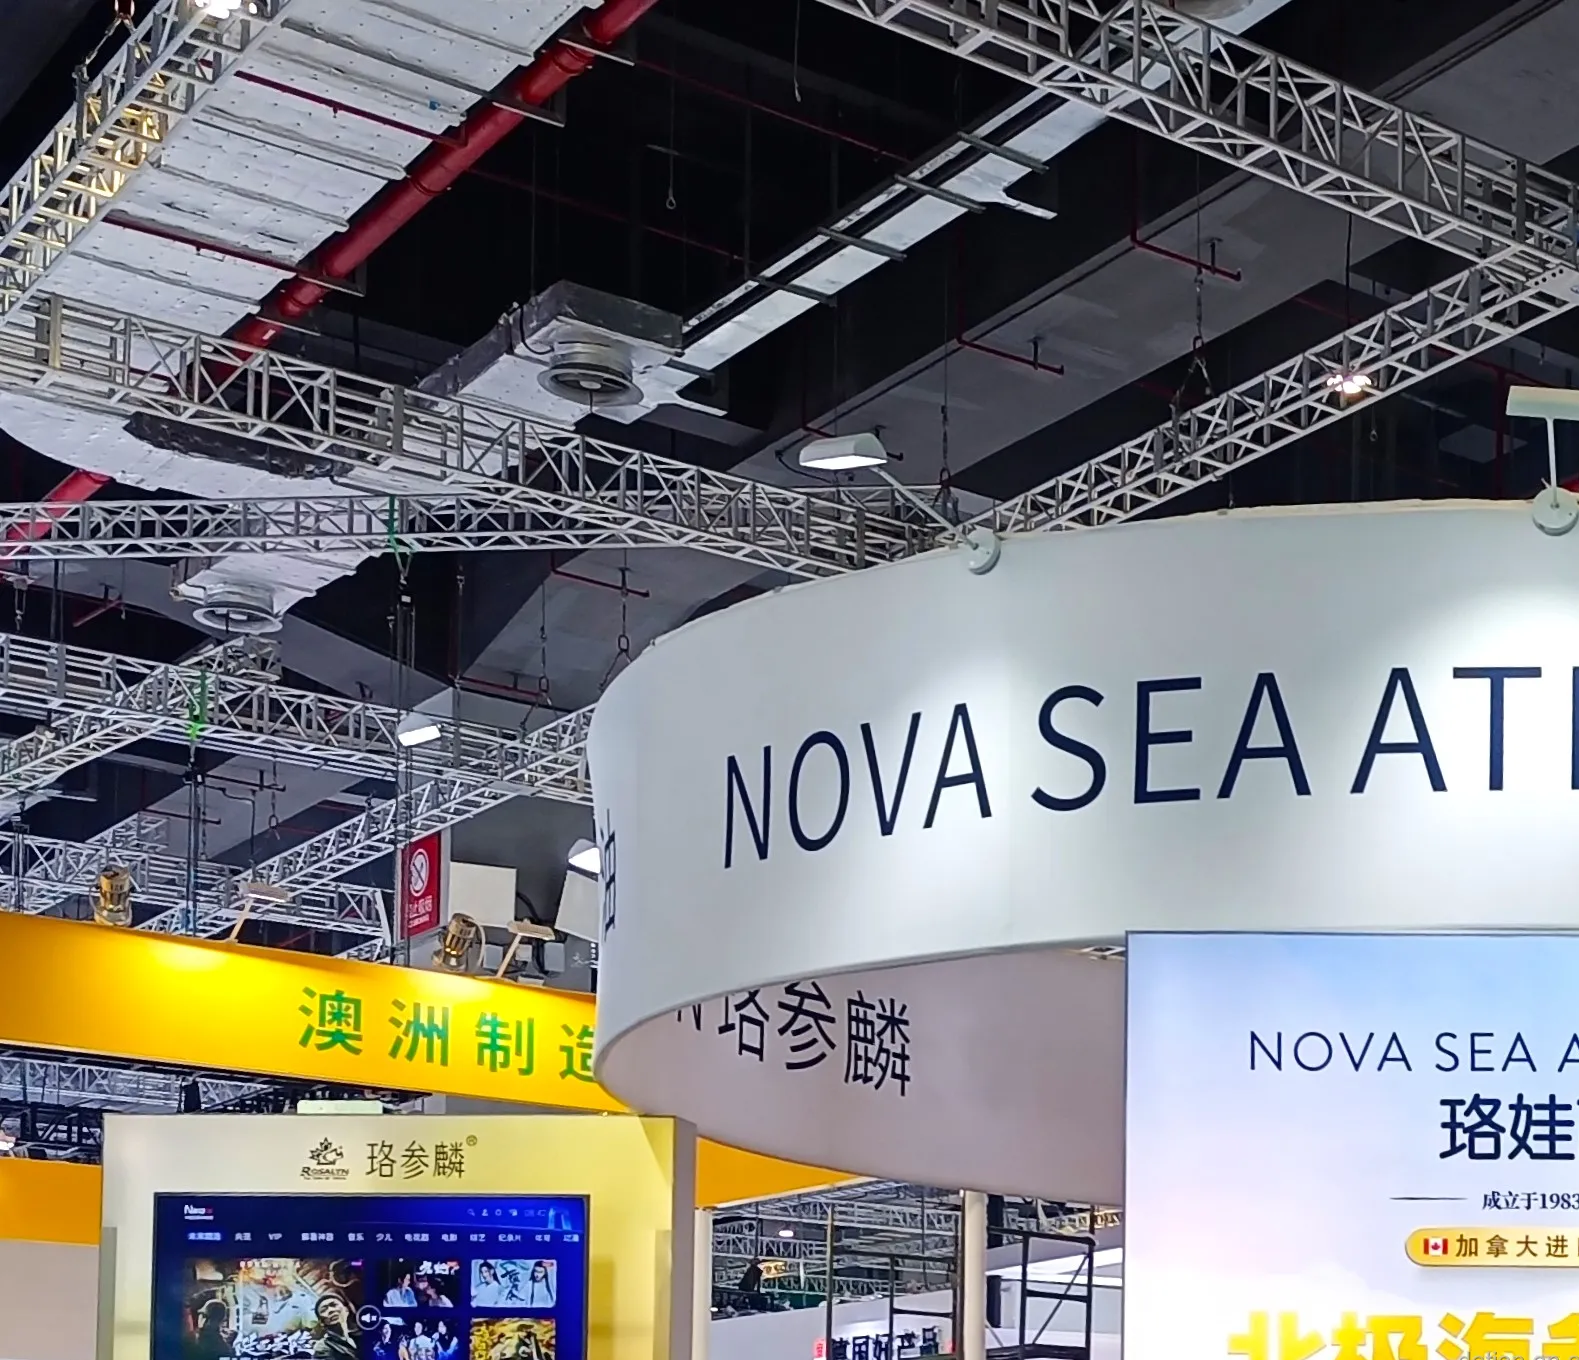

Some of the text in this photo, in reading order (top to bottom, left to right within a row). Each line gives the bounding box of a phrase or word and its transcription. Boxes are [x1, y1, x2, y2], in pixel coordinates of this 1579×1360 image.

[724, 702, 993, 869] NOVA
[1030, 672, 1312, 812] SEA
[297, 985, 597, 1082] 澳洲制造
[1249, 1030, 1412, 1073] NOVA
[1433, 1031, 1538, 1074] SEA
